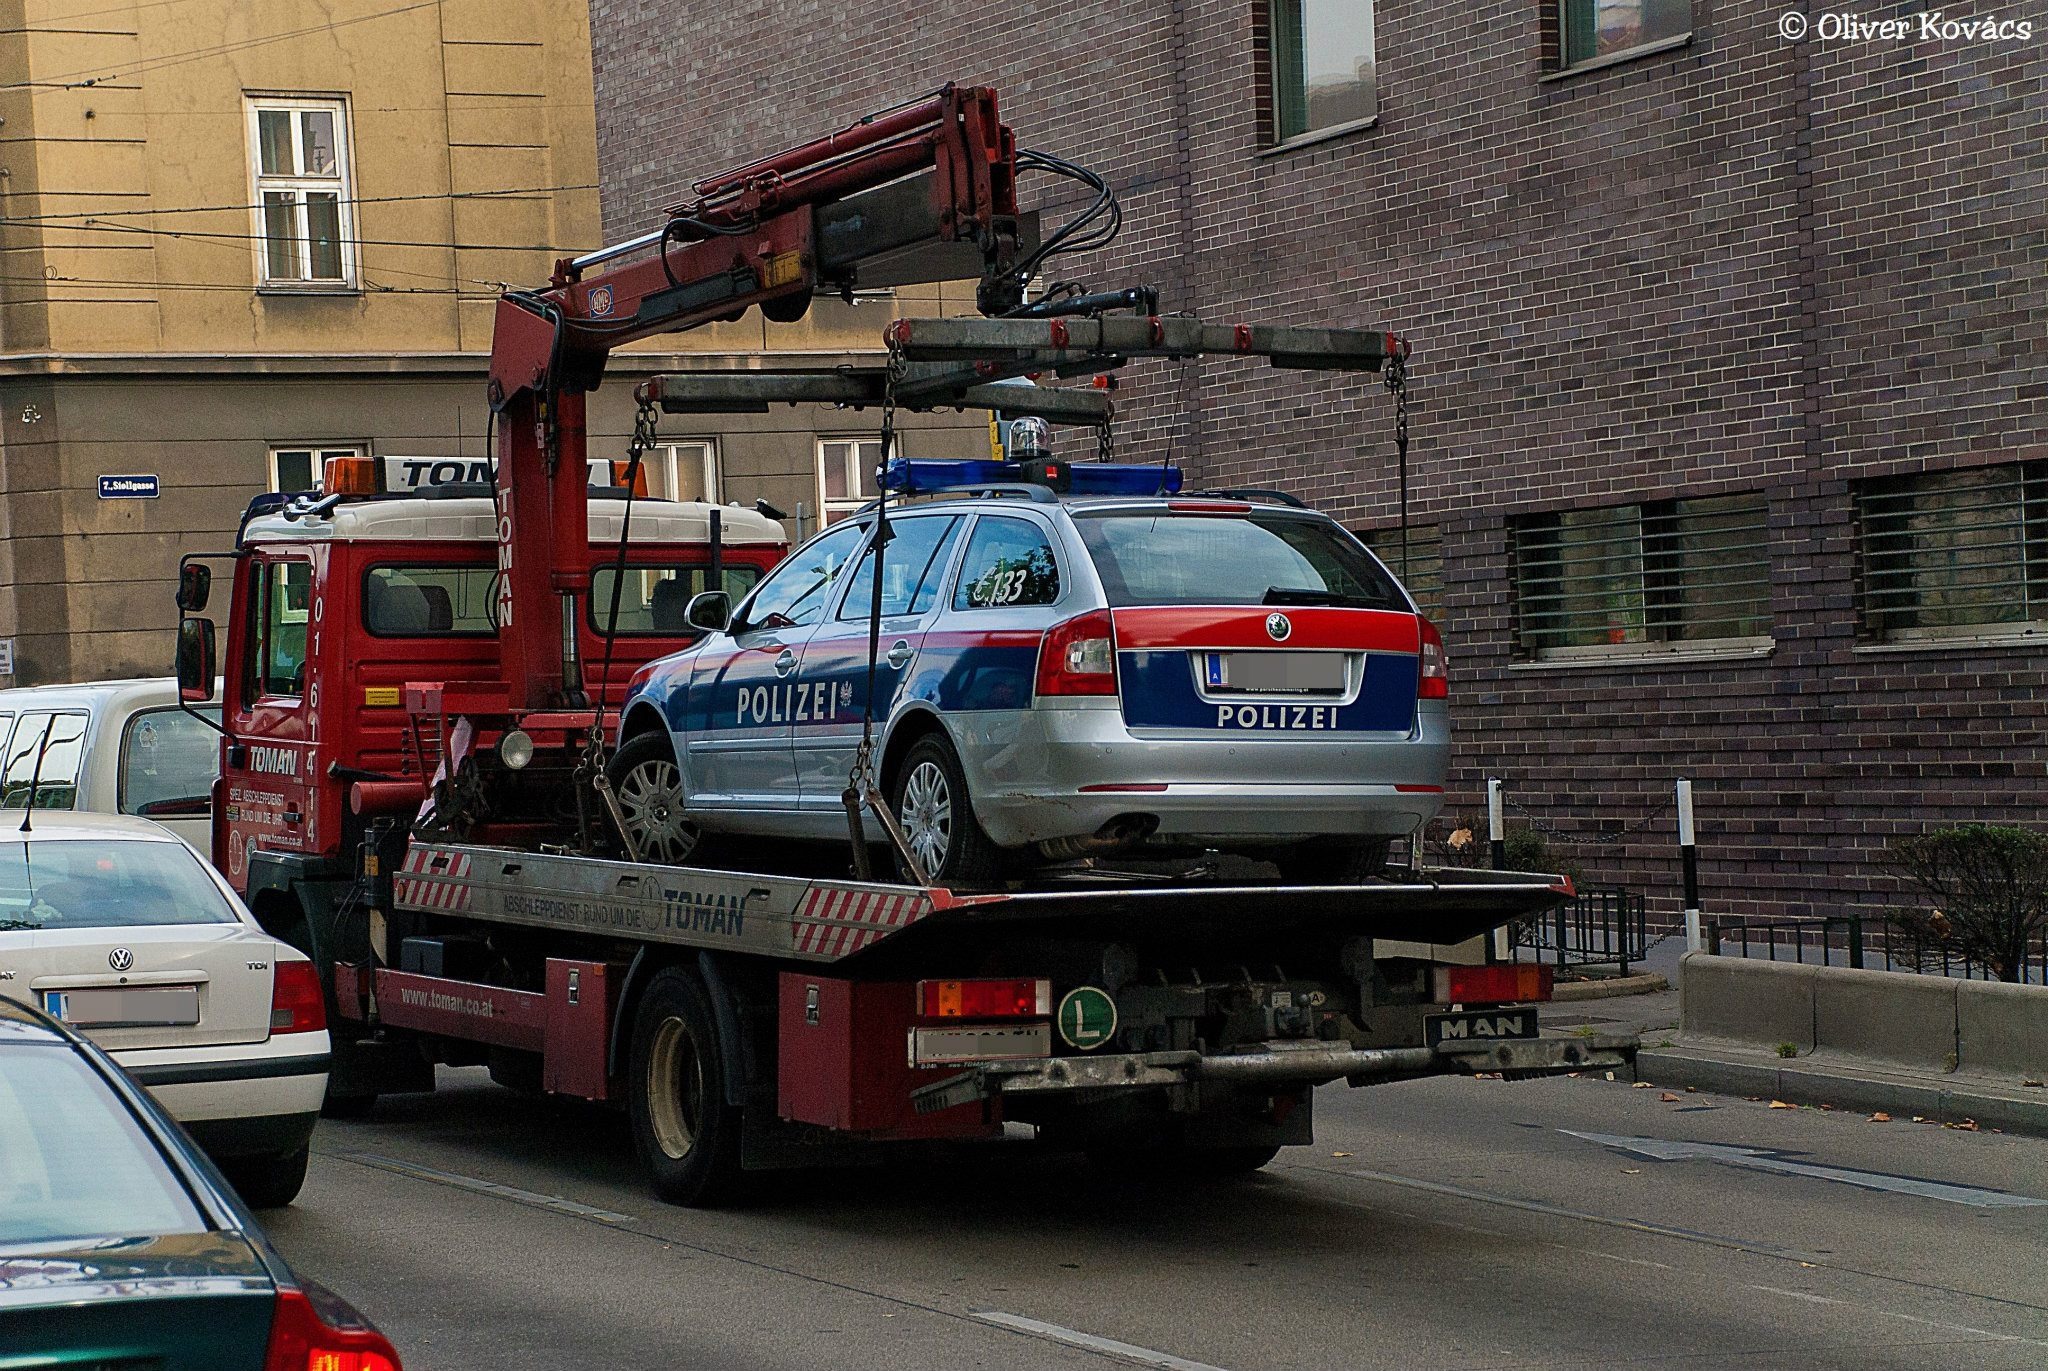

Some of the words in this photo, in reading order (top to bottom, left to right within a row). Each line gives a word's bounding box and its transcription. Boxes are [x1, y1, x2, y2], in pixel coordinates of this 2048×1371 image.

[498, 487, 512, 627] TOMAN
[737, 681, 837, 724] POLIZEI
[1217, 705, 1337, 728] POLIZEI
[250, 745, 298, 776] TOMAN
[583, 903, 608, 923] RUND
[610, 906, 625, 925] UM
[626, 908, 642, 928] DIE
[664, 889, 747, 936] TOMAN
[402, 987, 494, 1018] www.toman.co.at
[1074, 1000, 1100, 1038] L
[1441, 1015, 1523, 1040] MAN
